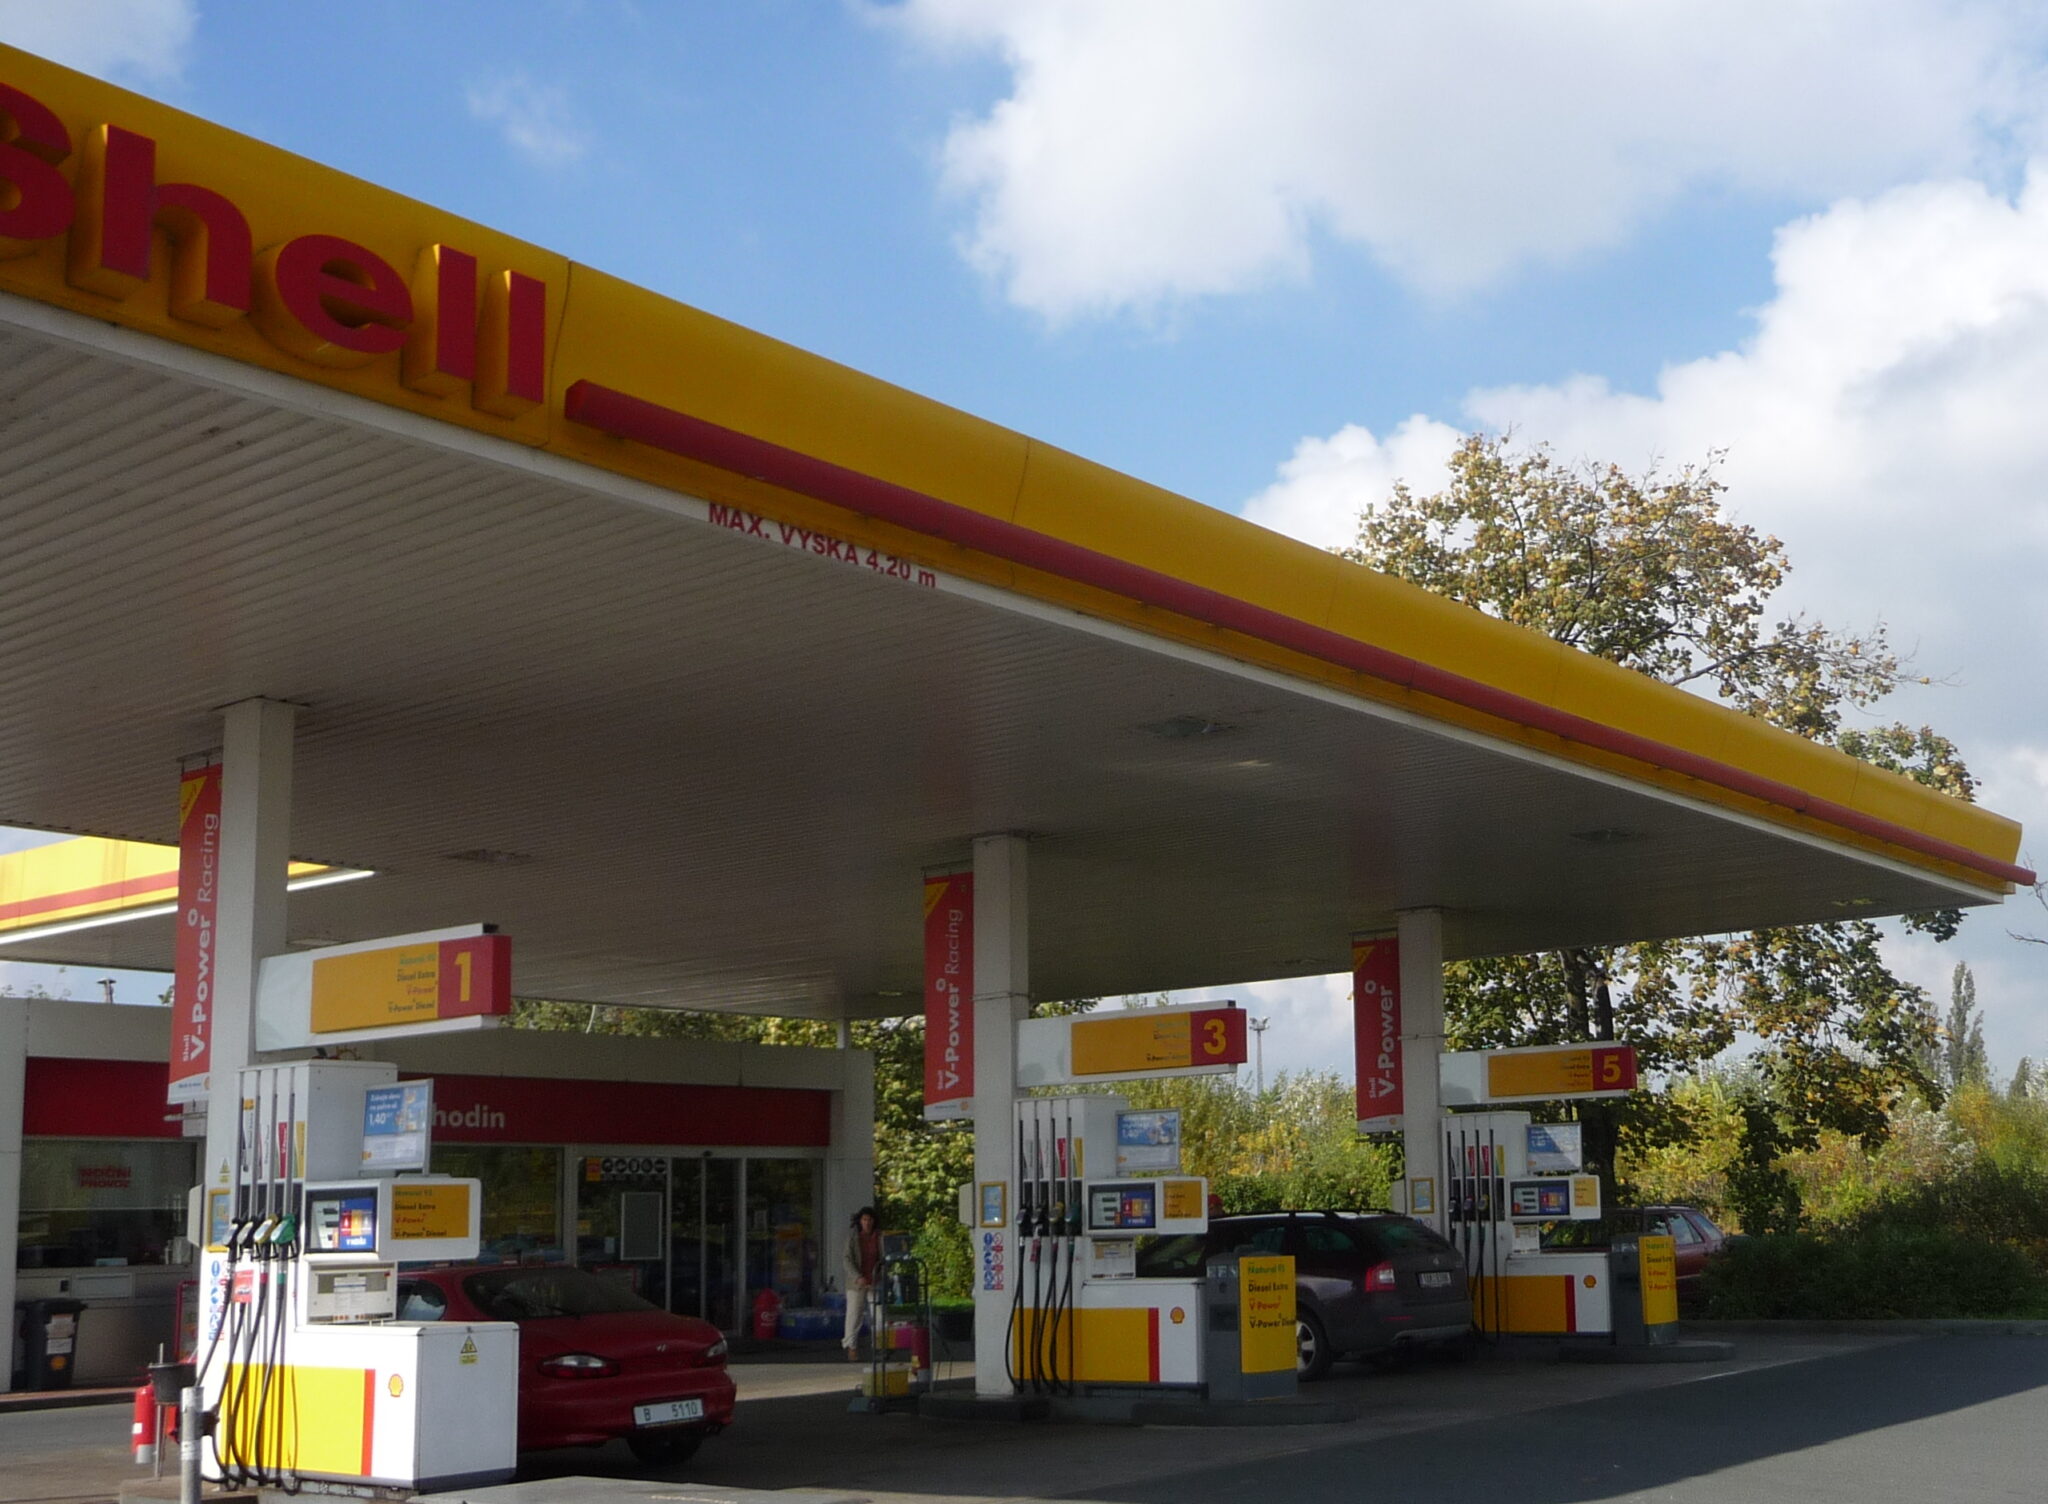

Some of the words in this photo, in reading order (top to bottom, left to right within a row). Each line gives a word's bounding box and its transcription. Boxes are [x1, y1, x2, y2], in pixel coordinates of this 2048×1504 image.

[0, 82, 547, 405] Shell
[708, 502, 771, 541] MAX.
[865, 549, 912, 581] 4,20
[918, 568, 937, 589] m
[197, 812, 219, 903] Racing
[453, 951, 472, 1002] 1
[944, 908, 964, 975] Racing
[190, 914, 211, 1061] V-Power
[182, 1034, 192, 1062] Shell
[944, 982, 961, 1090] V-Power
[1203, 1018, 1227, 1056] 3
[1377, 984, 1396, 1098] V-Power
[1602, 1054, 1621, 1083] 5
[432, 1102, 506, 1128] hodin
